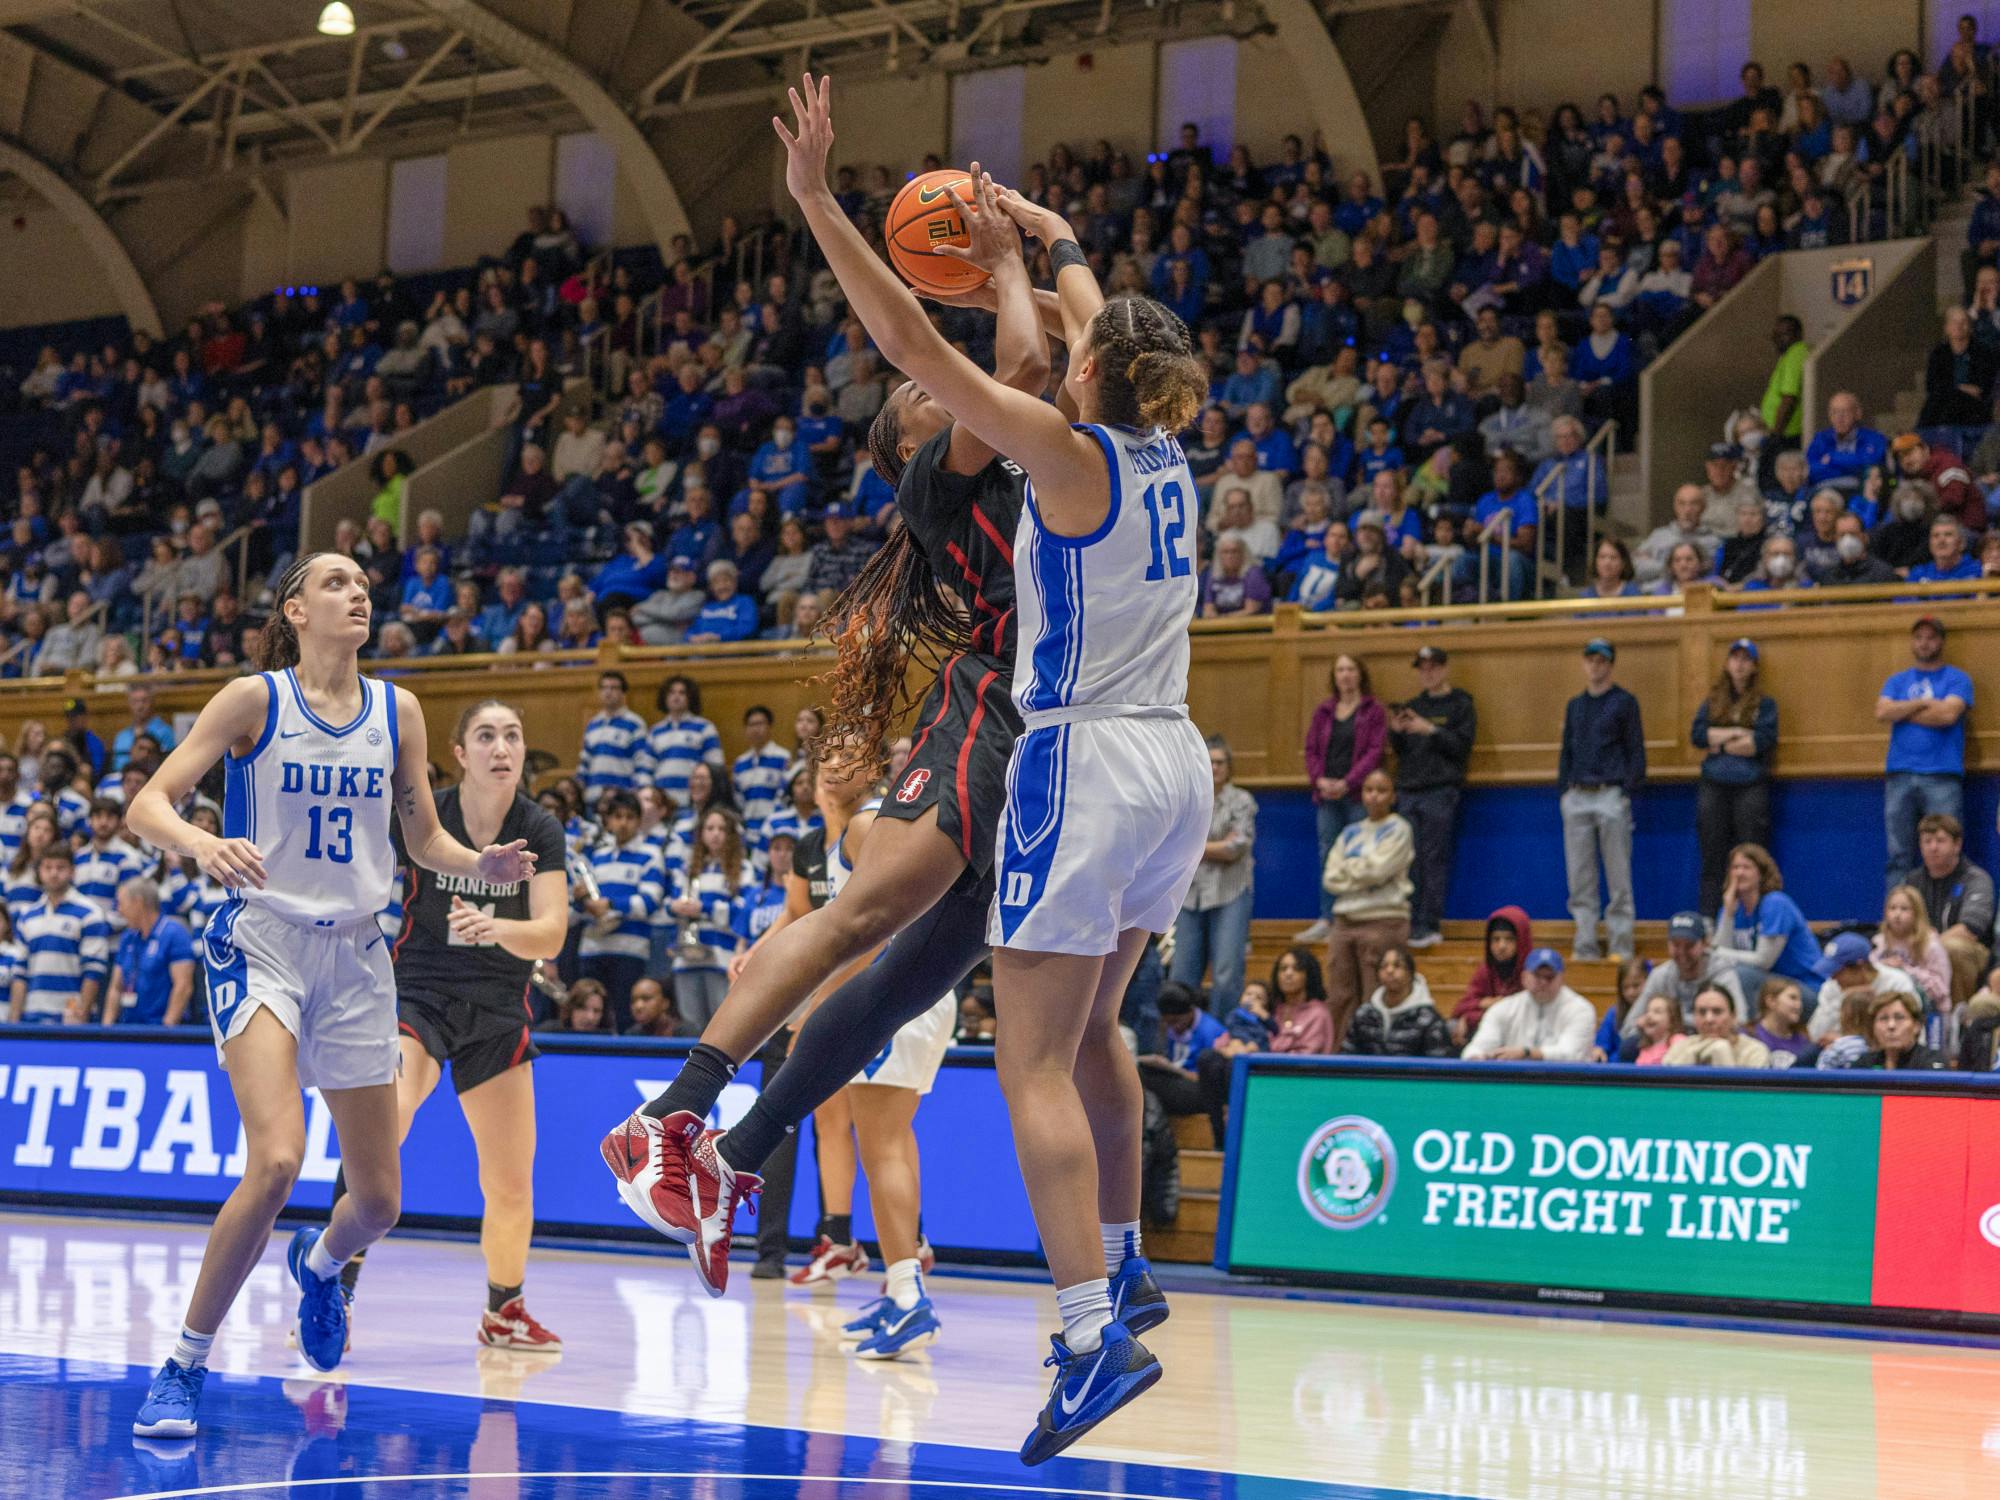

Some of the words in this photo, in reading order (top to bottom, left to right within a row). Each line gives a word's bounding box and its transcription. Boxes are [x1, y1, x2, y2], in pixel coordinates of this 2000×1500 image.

[928, 217, 968, 240] ELI
[1836, 269, 1864, 300] 14
[1123, 438, 1187, 476] THOMAS
[1143, 481, 1191, 581] 12
[281, 762, 384, 798] DUKE
[305, 805, 353, 864] 13
[1003, 871, 1033, 907] D
[214, 981, 237, 1016] D
[0, 1064, 343, 1183] TBAL
[1413, 1129, 1515, 1175] OLD
[1529, 1134, 1813, 1190] DOMINION
[1422, 1182, 1653, 1237] FREIGHT
[1666, 1194, 1794, 1243] LINE
